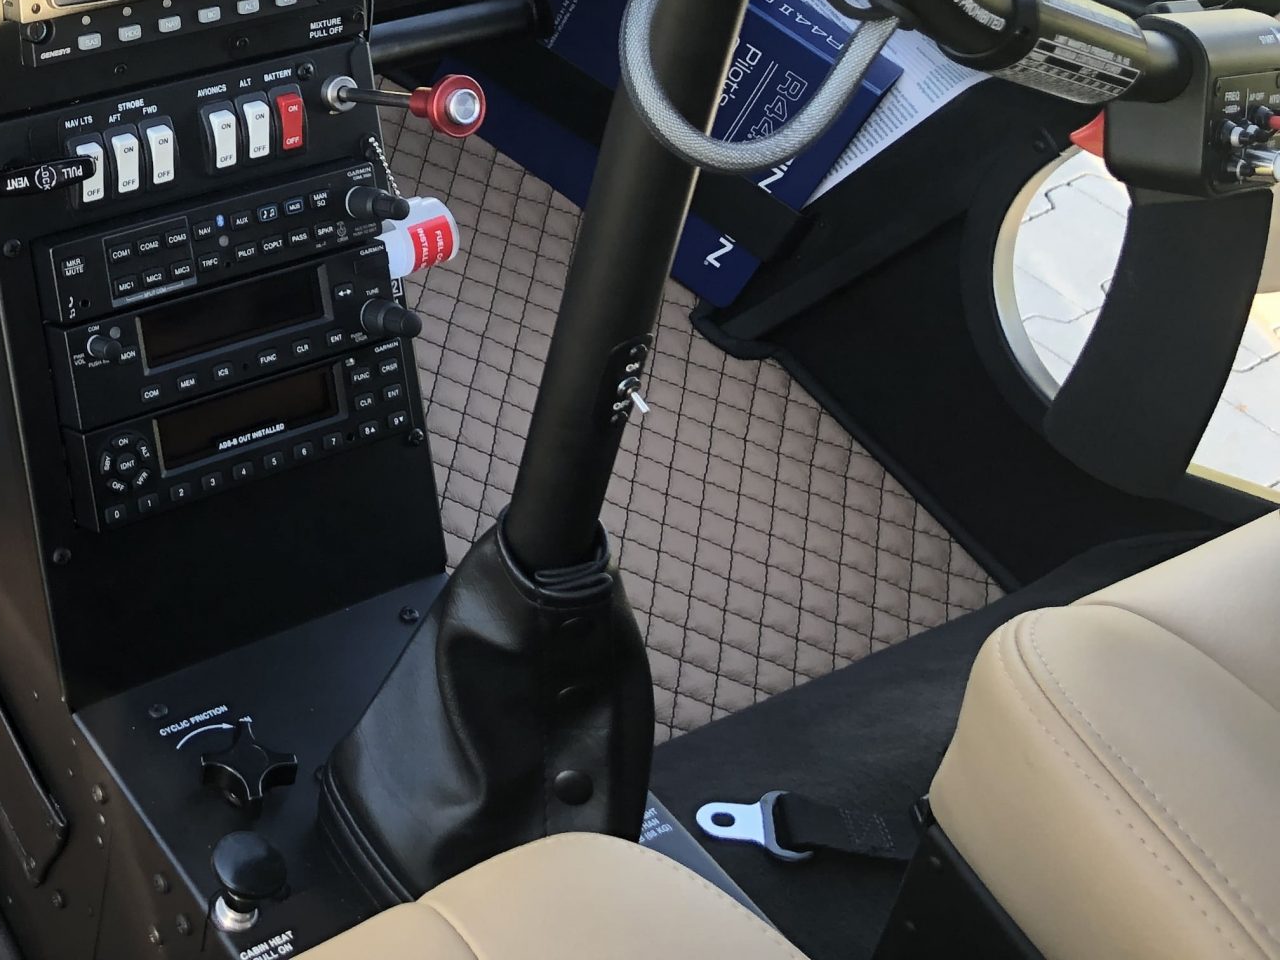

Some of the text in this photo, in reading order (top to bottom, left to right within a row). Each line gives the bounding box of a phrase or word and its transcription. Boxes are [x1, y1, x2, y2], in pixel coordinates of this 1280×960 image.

[310, 17, 342, 30] MIXTURE
[309, 25, 344, 39] PULL OFF
[197, 68, 292, 98] AVIONICS ALT BATTERY
[1224, 91, 1240, 102] FREQ
[118, 99, 144, 112] STROBE
[108, 105, 157, 123] AFT FWD
[65, 115, 93, 129] NAV LTS
[286, 136, 300, 145] OFF
[253, 145, 267, 153] OFF
[220, 154, 234, 163] OFF
[6, 165, 83, 191] PULL LOCK VENT
[157, 170, 171, 179] OFF
[122, 179, 136, 187] OFF
[87, 188, 101, 197] OFF
[112, 227, 211, 259] COM1 COM2 COM3 NAV
[238, 232, 308, 258] PILOT COPLT PASS
[359, 245, 384, 256] GARMIN
[119, 265, 190, 291] MIC1 MIC2 MIC3
[374, 341, 399, 353] GARMIN
[120, 350, 136, 360] MON
[260, 353, 277, 364] FUNC
[381, 363, 398, 373] CRSR
[353, 371, 370, 381] FUNC
[144, 368, 229, 399] COM MEM ICS
[252, 423, 285, 440] INSTALLED
[159, 719, 190, 737] CYCLIC
[190, 704, 228, 724] FRICTION
[240, 930, 293, 960] CABIN HEAT
[278, 942, 293, 954] ON
